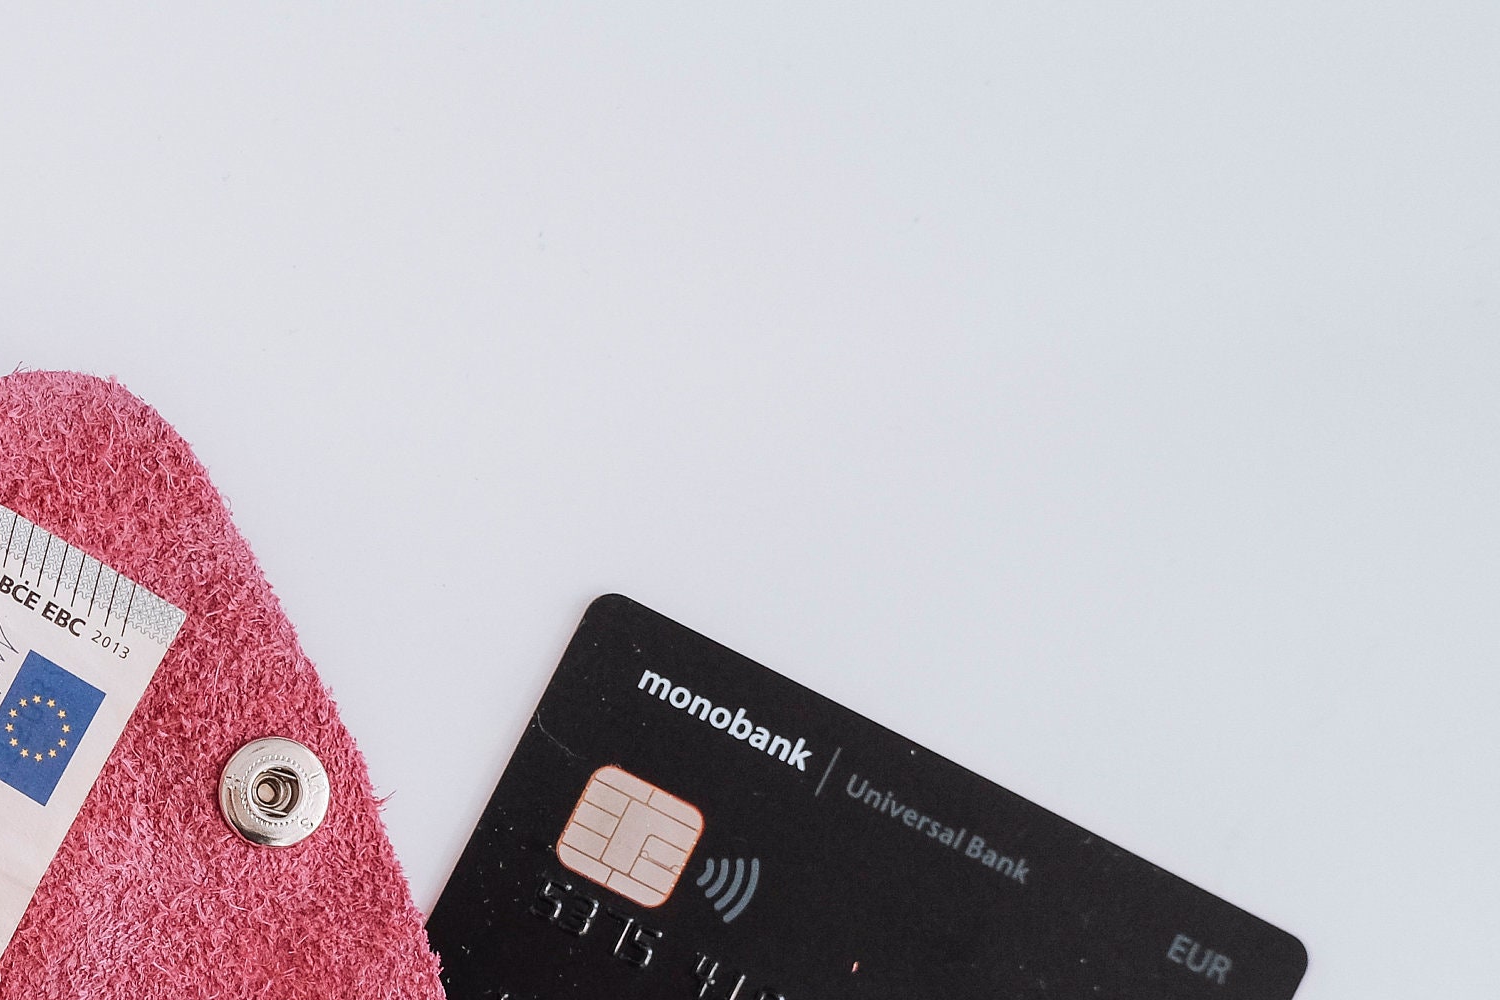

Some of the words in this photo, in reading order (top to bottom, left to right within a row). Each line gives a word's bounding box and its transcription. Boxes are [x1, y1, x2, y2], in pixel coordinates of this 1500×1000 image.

[41, 600, 86, 637] EBC
[91, 629, 131, 660] 2013
[637, 669, 813, 772] monobank
[846, 773, 967, 850] Universal
[965, 835, 1031, 885] Bank
[530, 880, 662, 968] 5375
[1166, 933, 1233, 984] EUR
